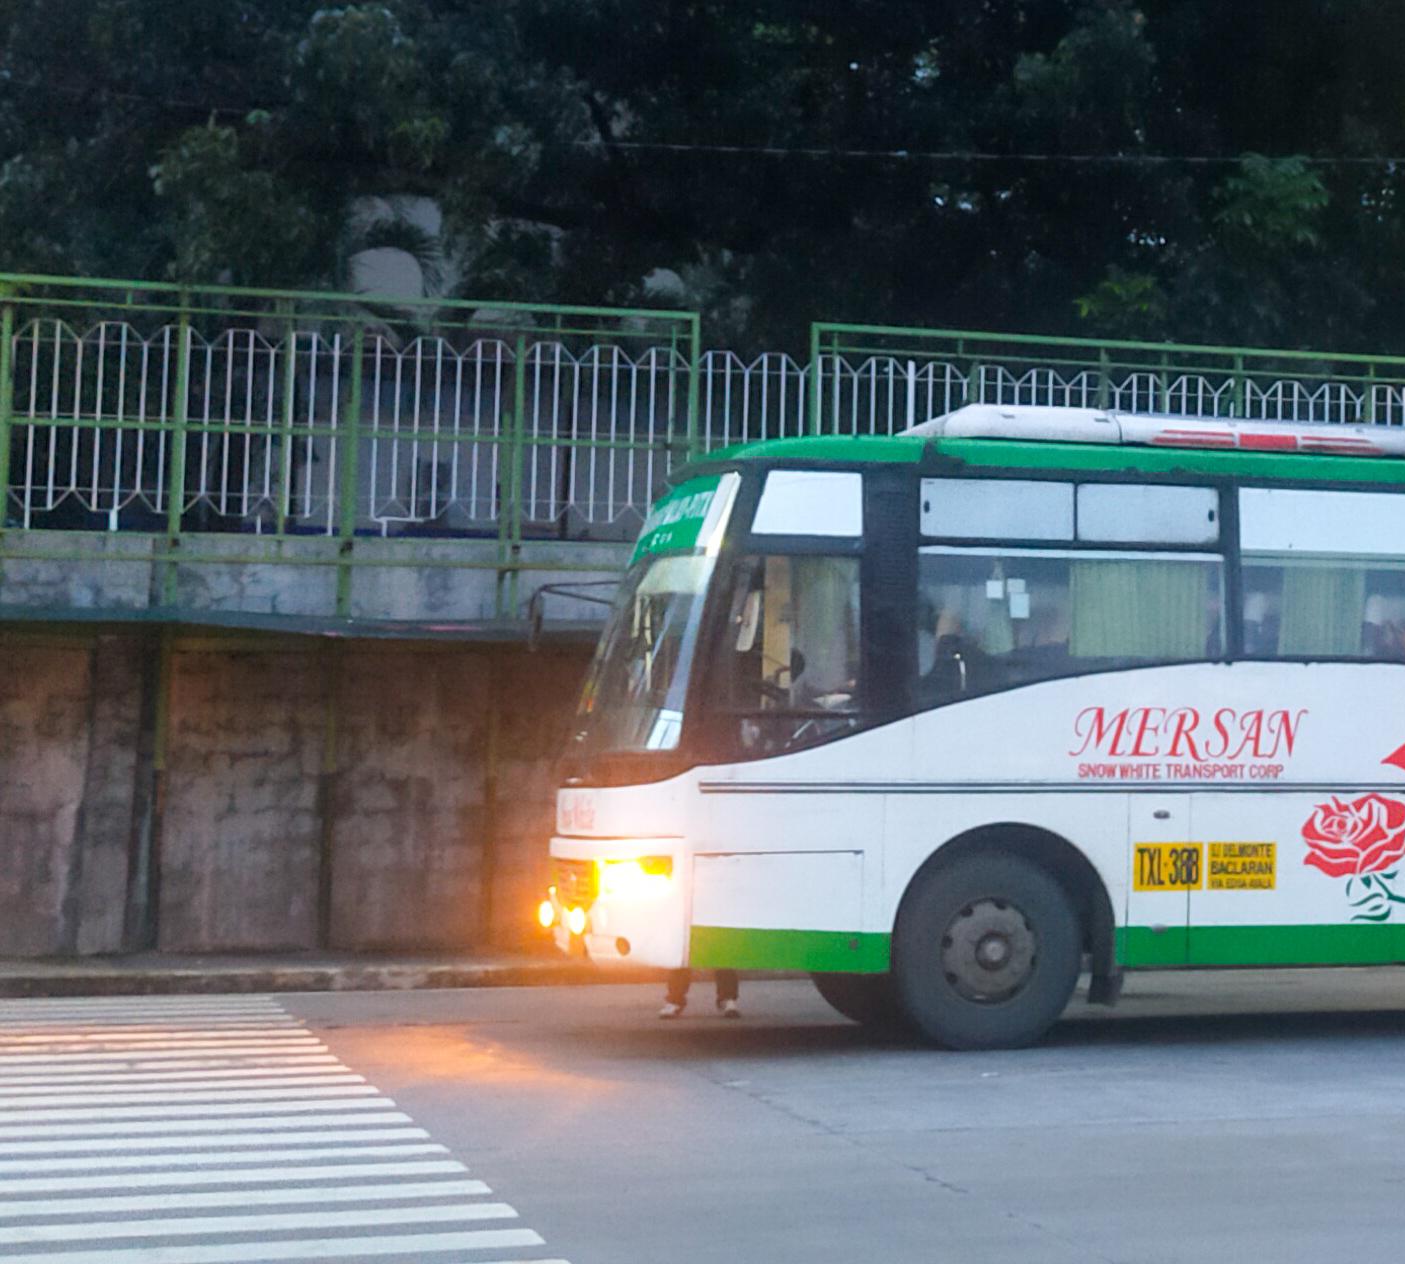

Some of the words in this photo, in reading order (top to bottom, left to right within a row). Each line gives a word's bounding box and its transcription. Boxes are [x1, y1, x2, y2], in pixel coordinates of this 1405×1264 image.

[1068, 706, 1309, 762] MERSAN
[1078, 763, 1115, 778] SNOW
[1119, 763, 1161, 778] WHITE
[1166, 763, 1245, 779] TRANSPORT
[1210, 860, 1273, 875] BACLARAN
